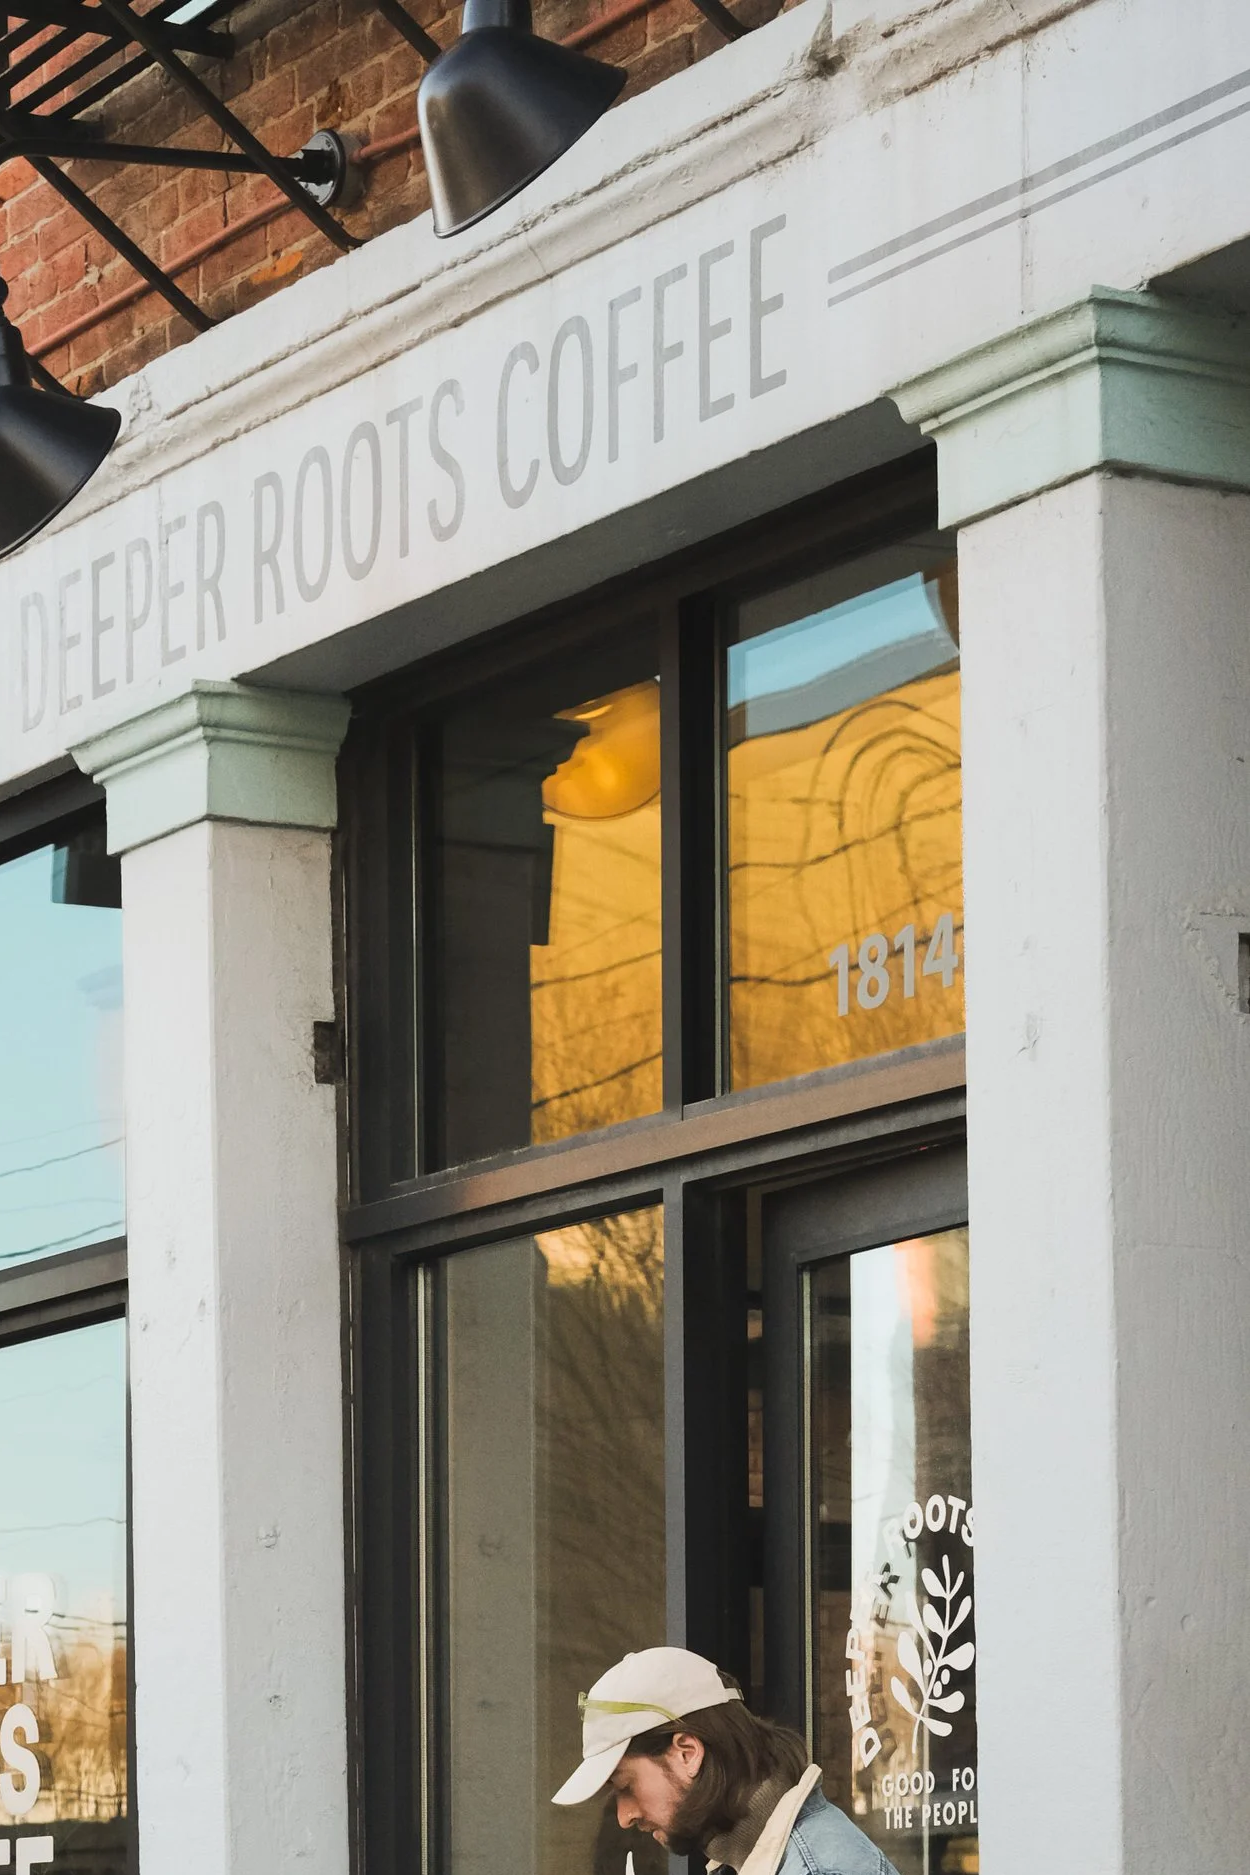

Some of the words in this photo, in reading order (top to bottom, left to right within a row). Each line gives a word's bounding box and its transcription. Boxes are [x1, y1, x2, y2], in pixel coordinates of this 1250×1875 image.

[21, 500, 226, 732] DEEPER
[253, 378, 466, 623] ROOTS
[497, 214, 787, 509] COFFEE
[829, 912, 958, 1017] 1814
[882, 1771, 935, 1797] GOOD
[952, 1767, 975, 1792] FO
[885, 1806, 913, 1830] THE
[922, 1800, 978, 1828] PEOPL
